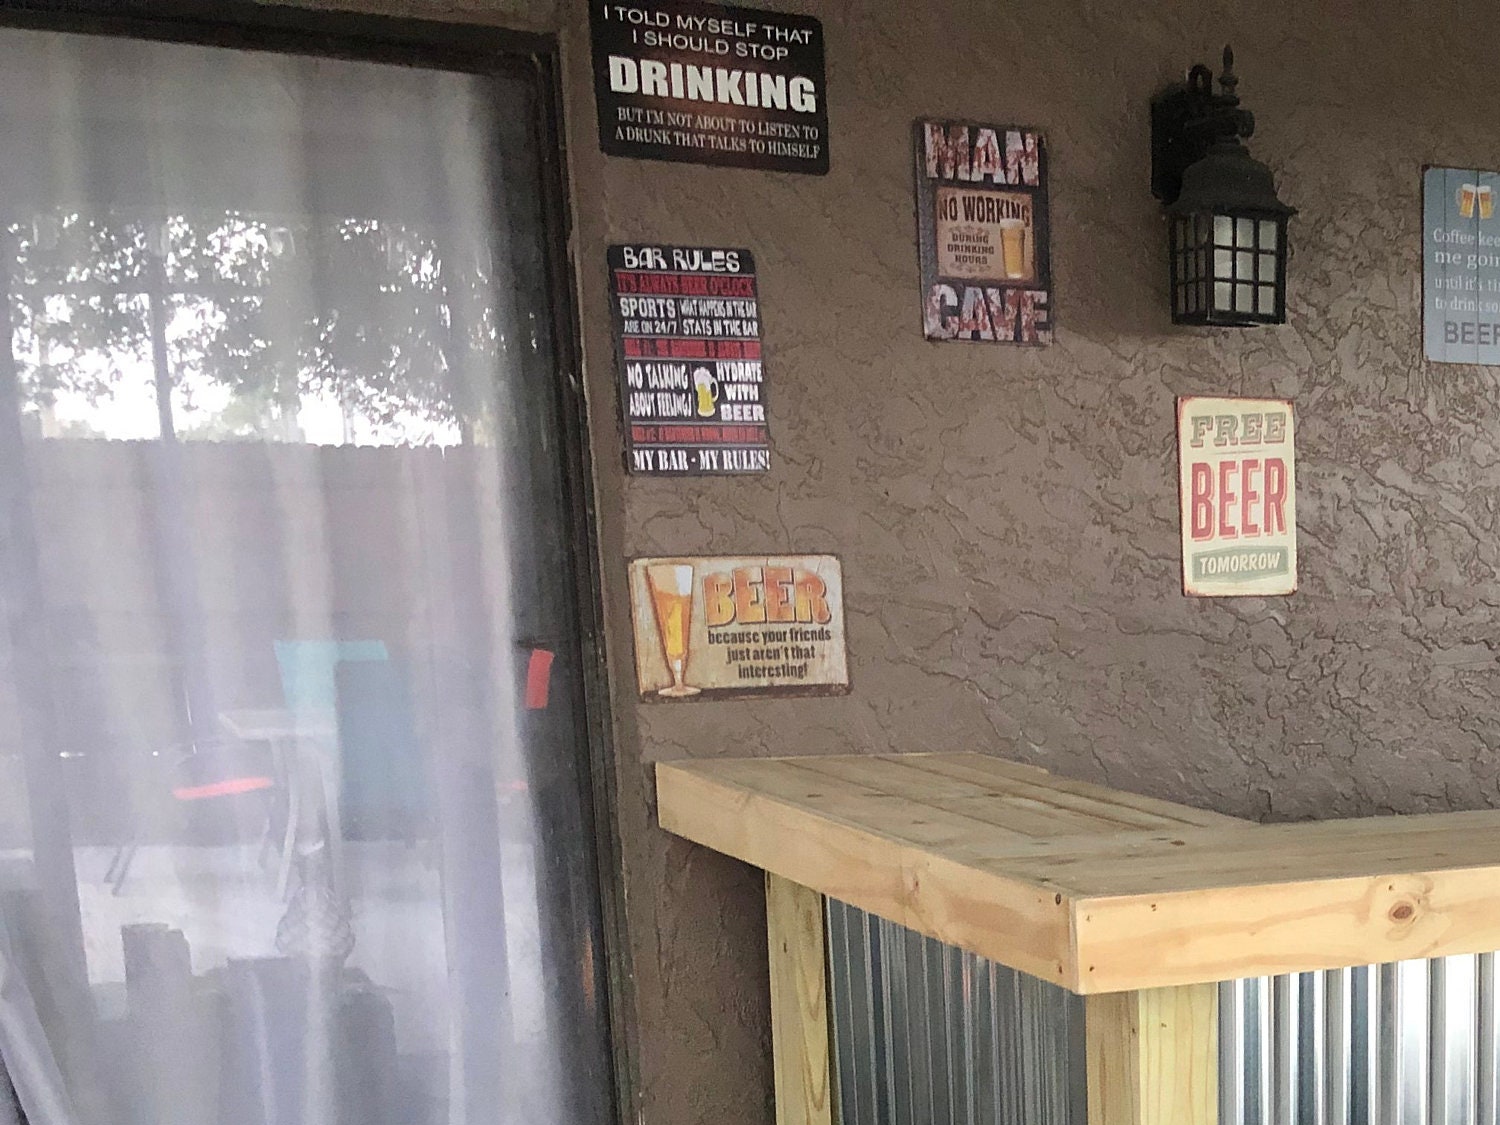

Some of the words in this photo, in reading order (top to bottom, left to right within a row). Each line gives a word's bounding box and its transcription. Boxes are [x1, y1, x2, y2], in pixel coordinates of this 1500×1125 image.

[603, 4, 609, 19] I
[615, 6, 670, 27] TOLD
[677, 15, 757, 37] MYSELF
[763, 25, 813, 45] THAT
[632, 29, 638, 43] I
[644, 30, 730, 55] SHOULD
[736, 41, 789, 61] STOP
[608, 55, 817, 113] DRINKING
[618, 106, 644, 122] BUT
[646, 109, 664, 124] I'M
[667, 111, 692, 127] NOT
[695, 114, 738, 133] ABOUT
[739, 119, 755, 134] TO
[758, 121, 800, 137] LISTEN
[803, 126, 818, 140] TO
[615, 127, 624, 140] A
[626, 127, 671, 145] DRUNK
[673, 131, 706, 148] THAT
[707, 134, 747, 152] TALKS
[749, 138, 765, 153] TO
[768, 141, 821, 159] HIMSELF
[924, 122, 1040, 187] MAN
[938, 196, 958, 221] NO
[962, 196, 1030, 227] WORKING
[952, 233, 989, 244] DURING
[1433, 227, 1475, 245] Coffee
[623, 247, 668, 269] BAR
[673, 249, 740, 273] RULES
[947, 244, 994, 255] DRINKING
[954, 254, 988, 265] HOURS
[1434, 251, 1462, 265] me
[620, 297, 676, 318] SPORTS
[926, 284, 1052, 343] CAVE
[654, 320, 677, 334] 24/7
[683, 319, 712, 336] STAYS
[626, 362, 643, 390] NO
[645, 363, 689, 390] TALKING
[715, 361, 763, 383] HYDRATE
[724, 384, 759, 402] WITH
[720, 403, 765, 422] BEER
[1190, 412, 1286, 448] FREE
[633, 449, 654, 471] MY
[658, 449, 689, 471] BAR
[698, 449, 720, 471] MY
[722, 449, 771, 471] RULES!
[1191, 458, 1288, 542] BEER
[1200, 552, 1281, 575] TOMORROW
[702, 566, 832, 628] BEER
[708, 629, 760, 645] because
[762, 629, 788, 646] your
[789, 627, 831, 643] friends
[726, 647, 751, 664] just
[752, 645, 789, 661] aren't
[791, 645, 816, 660] that
[738, 662, 808, 680] interesting!
